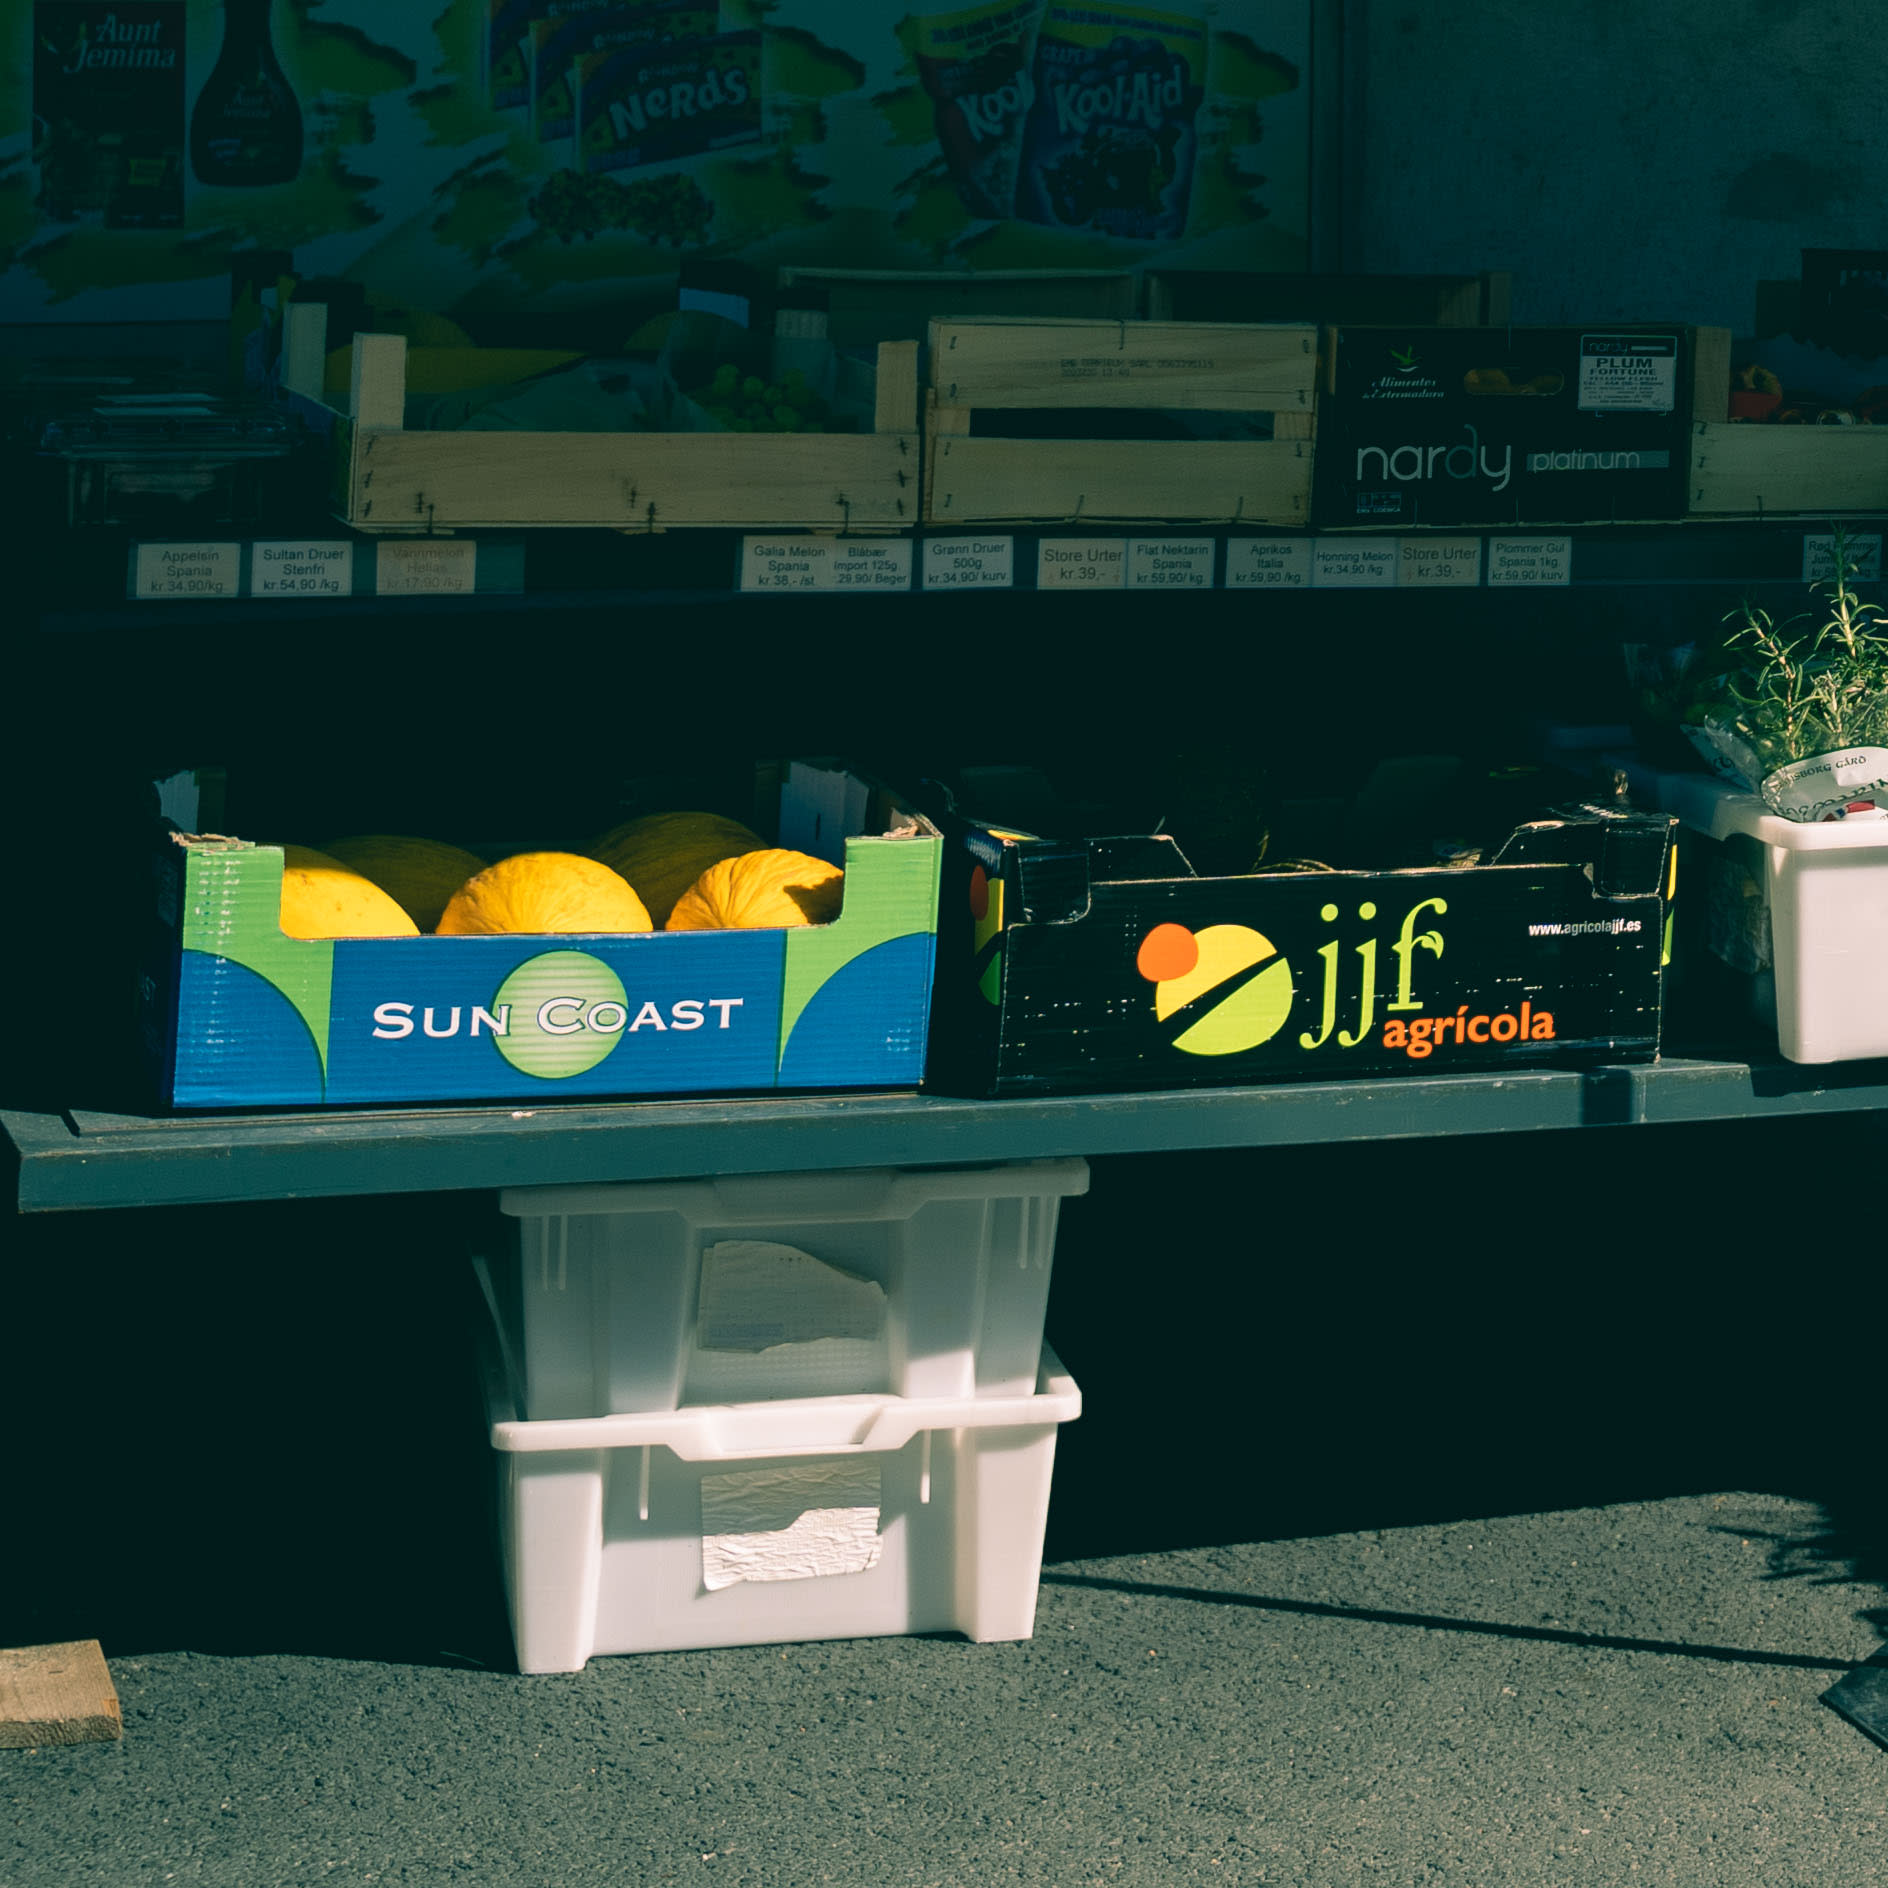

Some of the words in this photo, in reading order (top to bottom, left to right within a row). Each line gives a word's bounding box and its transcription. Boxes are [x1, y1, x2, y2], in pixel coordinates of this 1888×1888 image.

[96, 11, 162, 43] Aunt
[63, 39, 176, 74] Jemima
[1596, 358, 1652, 368] PLUM
[1356, 424, 1512, 492] nardy
[1533, 449, 1640, 474] platinum
[263, 549, 305, 561] Sultan
[308, 549, 345, 561] Druer
[789, 545, 825, 557] Melon
[932, 544, 969, 555] Grønn
[973, 543, 1005, 554] Druer
[1044, 549, 1083, 562] Store
[1087, 549, 1122, 562] Urter
[1162, 544, 1209, 555] Nektarin
[1403, 547, 1440, 560] Store
[1443, 548, 1477, 560] Urter
[953, 557, 982, 570] 500g
[1316, 552, 1359, 563] Honning
[1362, 552, 1394, 562] Melon
[282, 563, 326, 576] Stenfri
[1528, 918, 1642, 936] www.agricolajjf.es
[1298, 896, 1449, 1051] jjf
[371, 1003, 510, 1040] SUN
[535, 995, 746, 1035] COAST
[1383, 1001, 1556, 1058] agrícola
